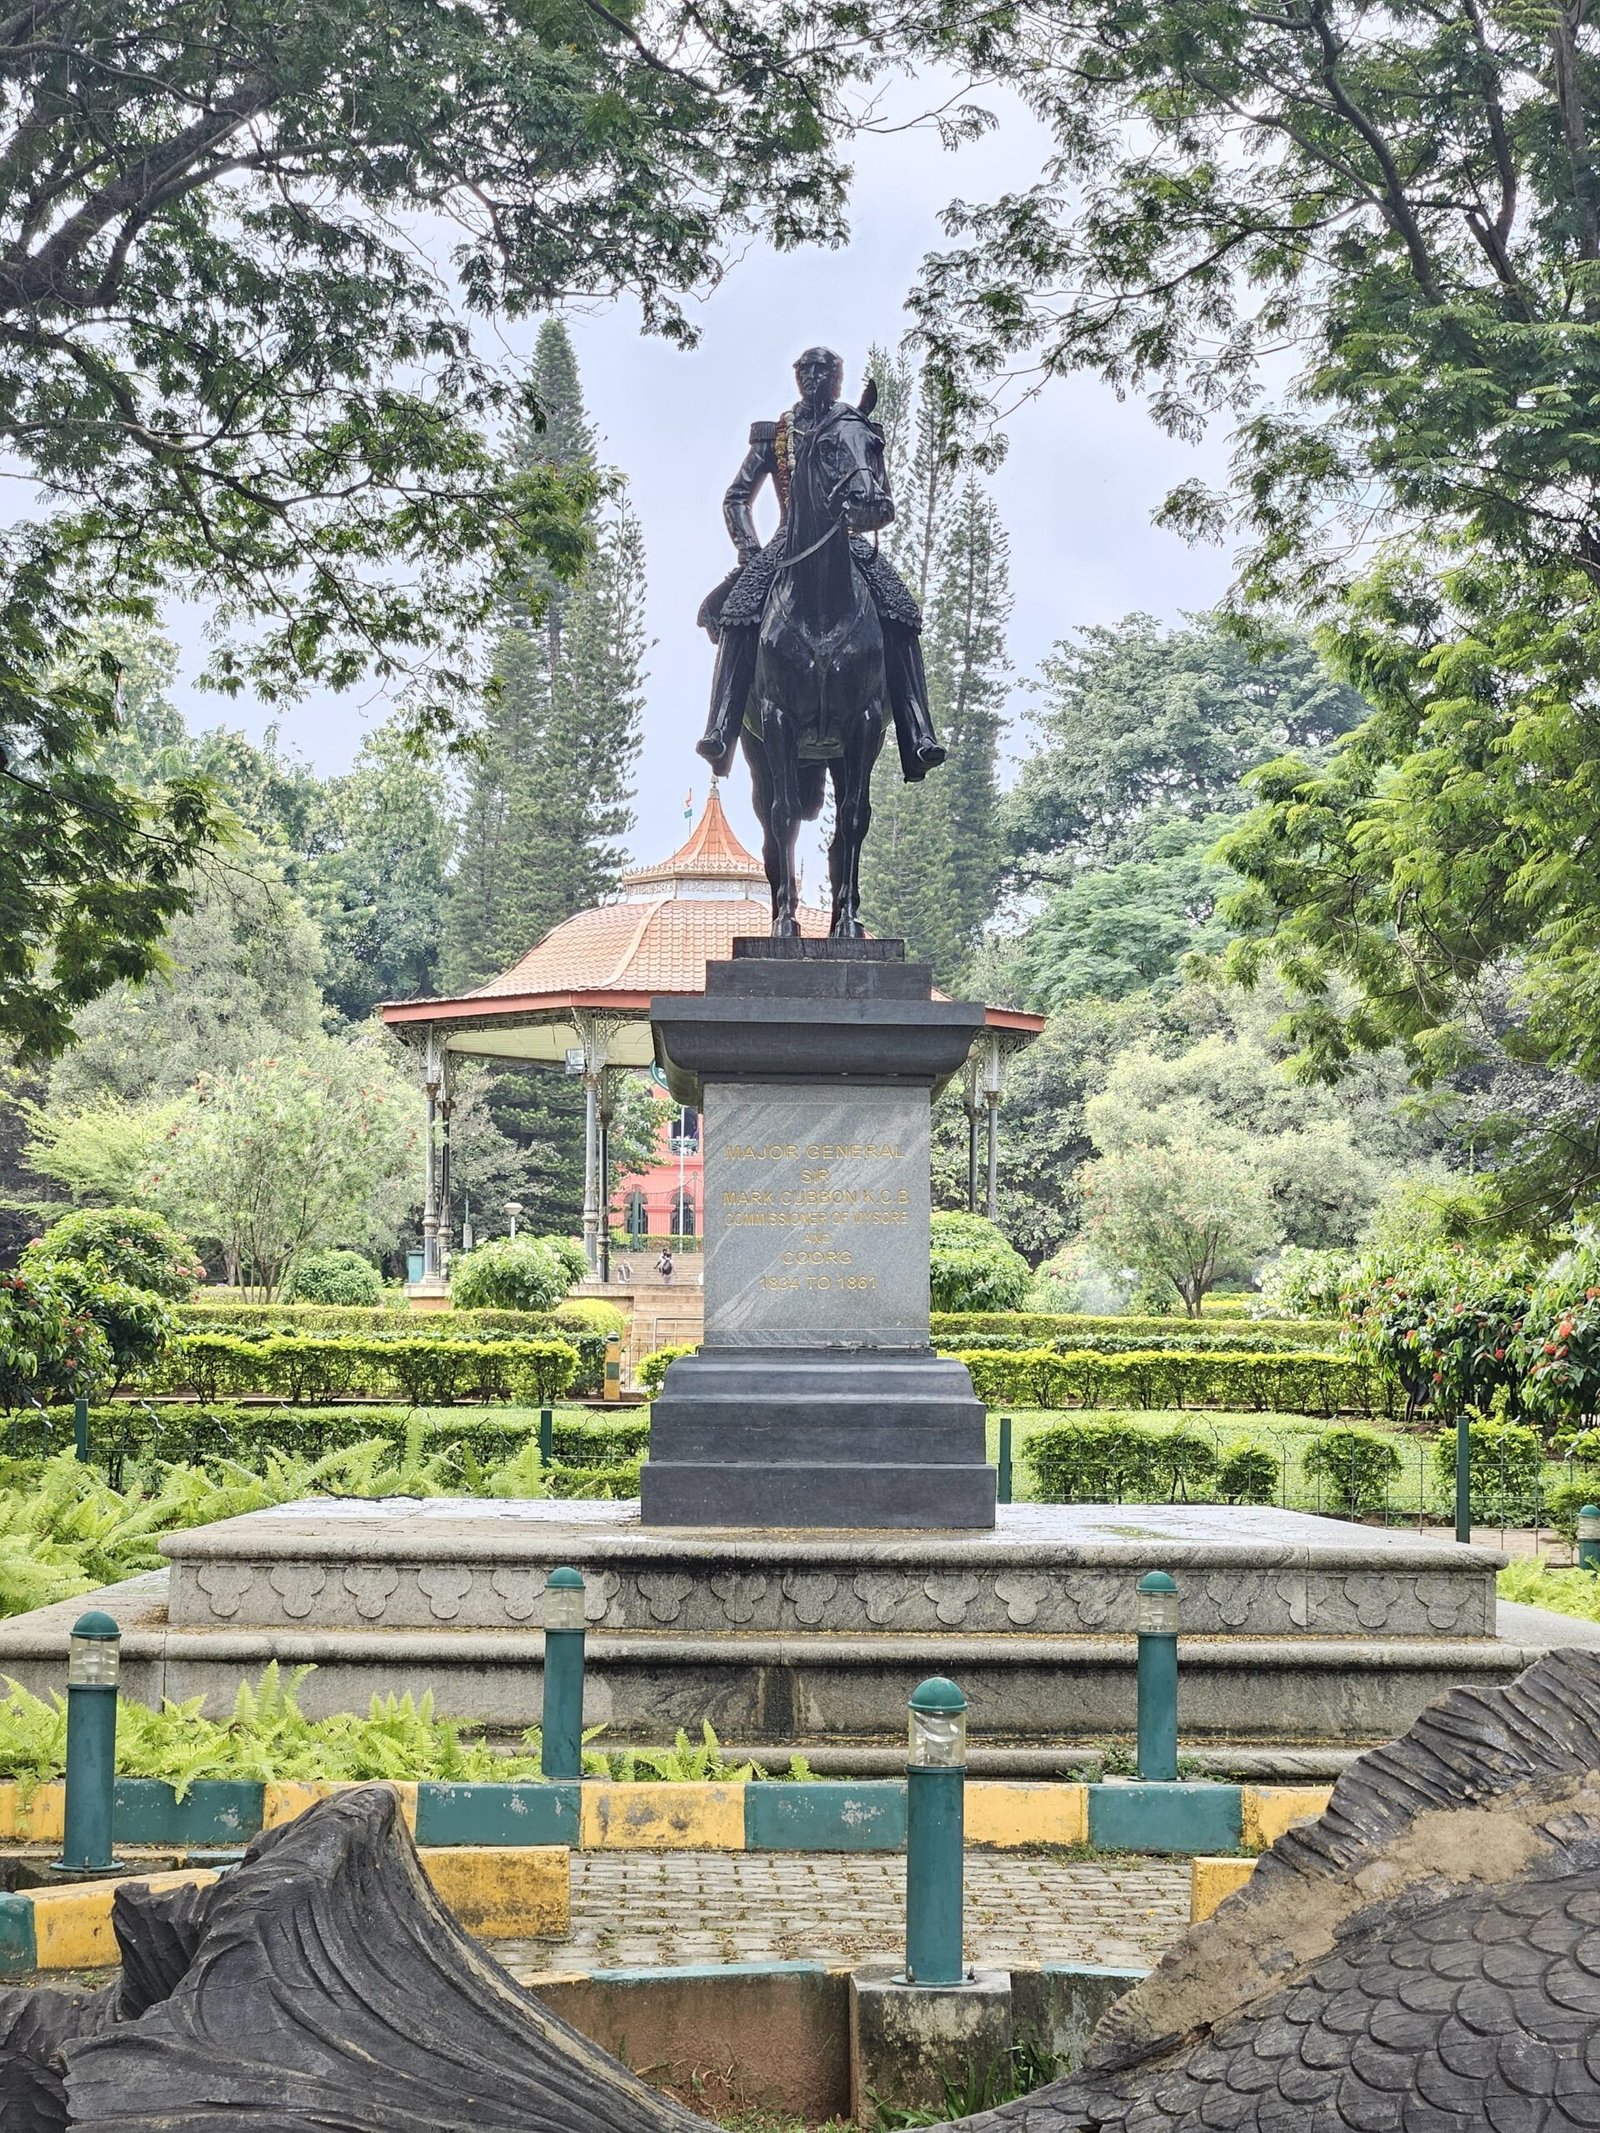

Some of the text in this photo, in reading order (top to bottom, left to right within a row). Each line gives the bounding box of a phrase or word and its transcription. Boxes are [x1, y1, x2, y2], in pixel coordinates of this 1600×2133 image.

[725, 1143, 905, 1160] MAJOR GENERAL
[801, 1168, 830, 1184] SIR
[723, 1190, 775, 1206] MARK
[780, 1189, 857, 1206] CUBBON
[724, 1210, 909, 1227] COMMISSIONER OF MYSORE
[802, 1232, 833, 1244] AND
[782, 1250, 853, 1265] COORG
[759, 1275, 877, 1291] 1834 TO 1861
